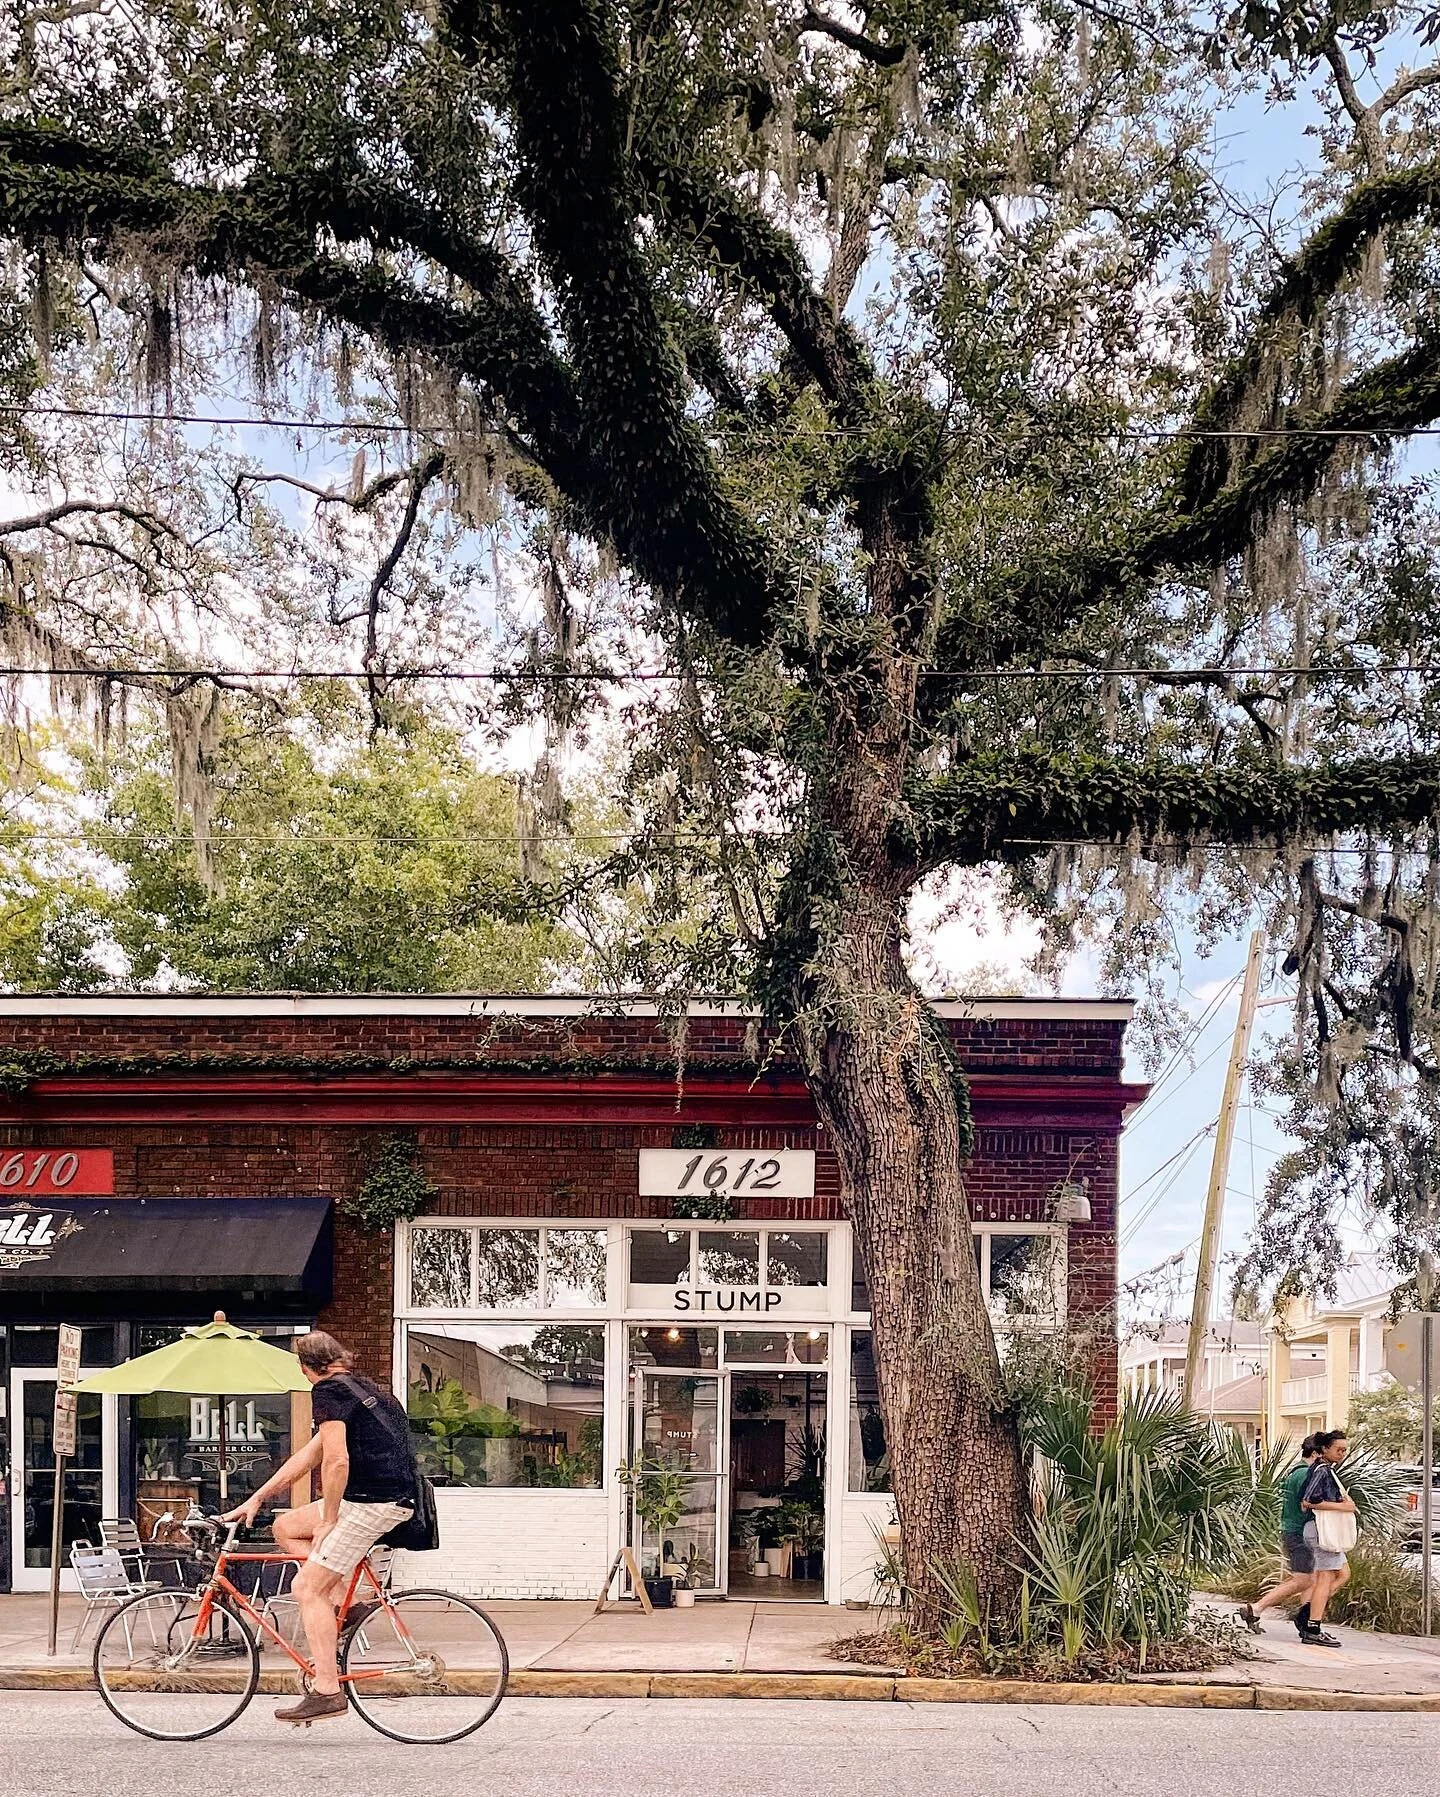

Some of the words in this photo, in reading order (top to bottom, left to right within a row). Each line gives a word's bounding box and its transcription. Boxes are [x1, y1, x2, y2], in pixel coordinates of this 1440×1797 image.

[0, 1153, 79, 1186] 610
[677, 1154, 782, 1190] 1612
[673, 1290, 782, 1311] STUMP
[188, 1397, 265, 1441] BELL
